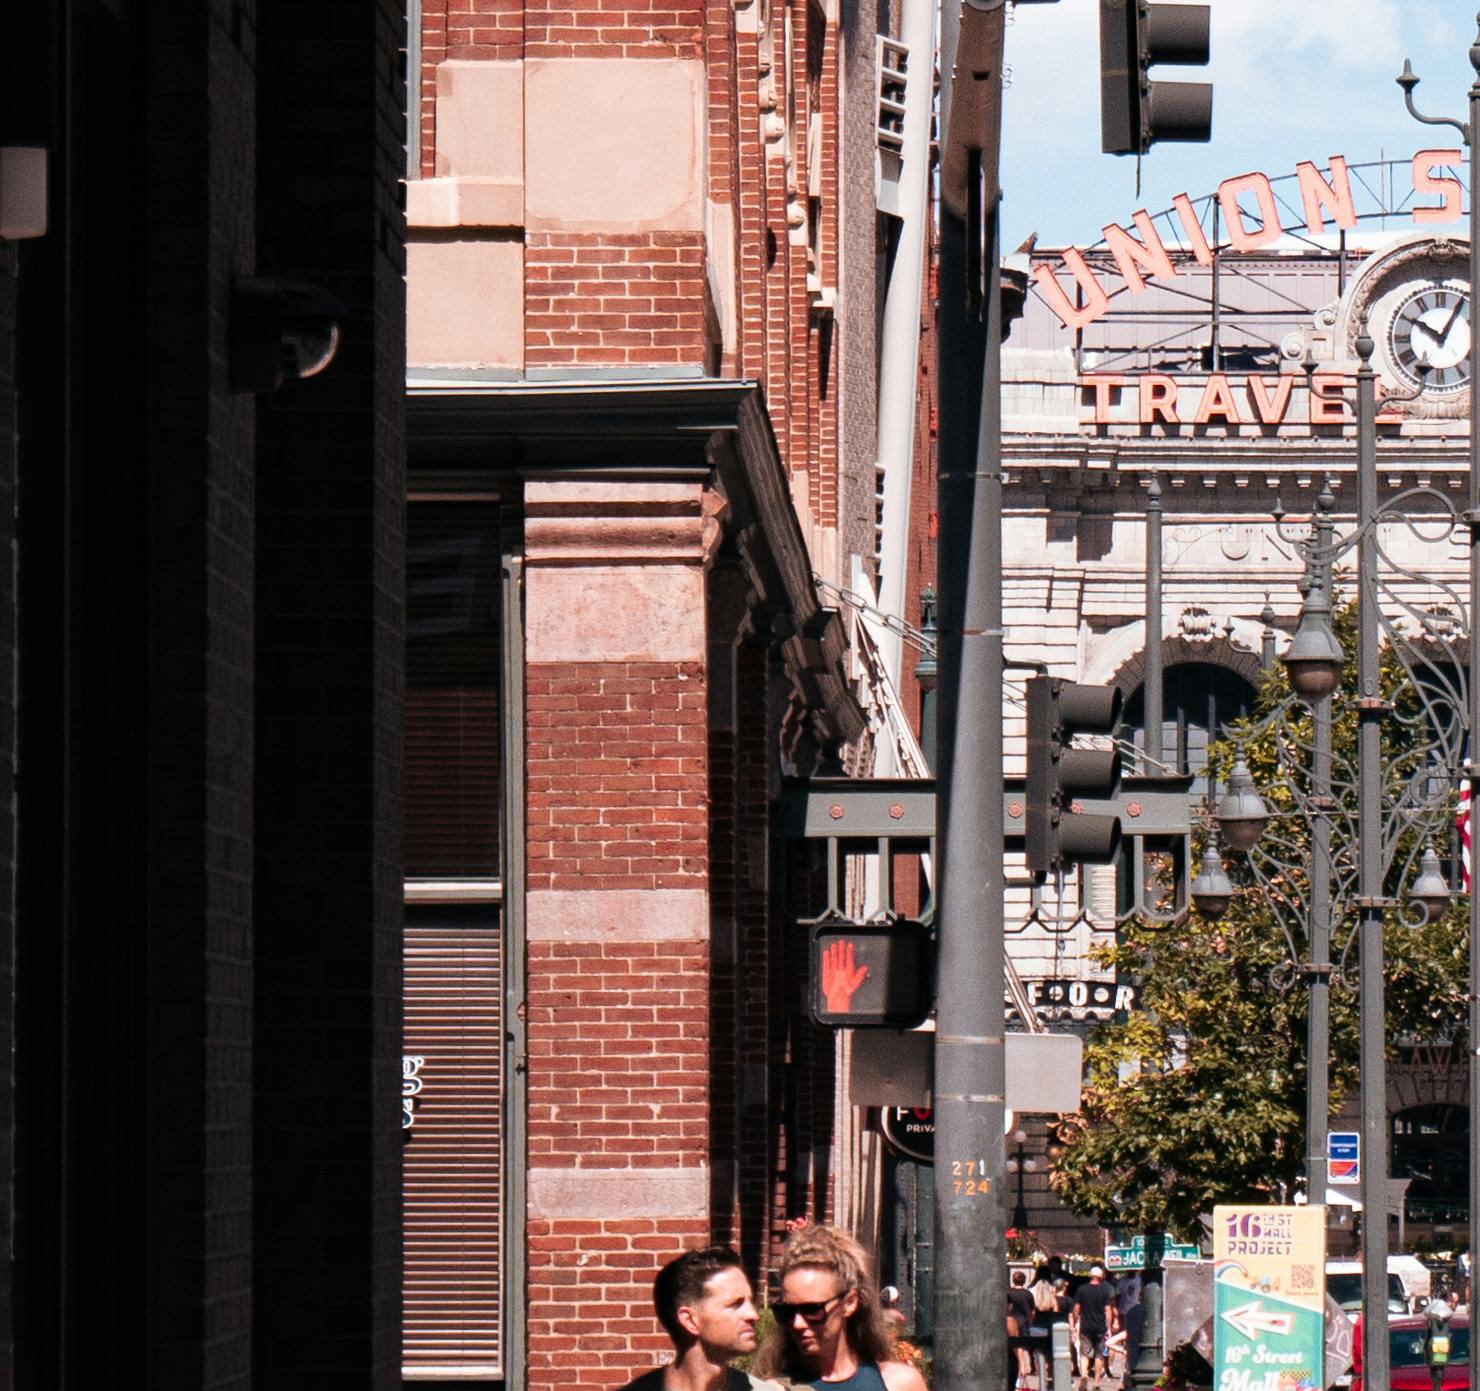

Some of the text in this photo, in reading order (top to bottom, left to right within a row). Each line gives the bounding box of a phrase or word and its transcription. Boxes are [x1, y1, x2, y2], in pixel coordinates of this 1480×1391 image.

[1033, 154, 1357, 329] UNION
[951, 1159, 986, 1177] 271
[953, 1180, 990, 1196] 724
[1226, 1213, 1261, 1238] 16
[1228, 1240, 1293, 1256] PROJECT
[1252, 1343, 1304, 1364] Street
